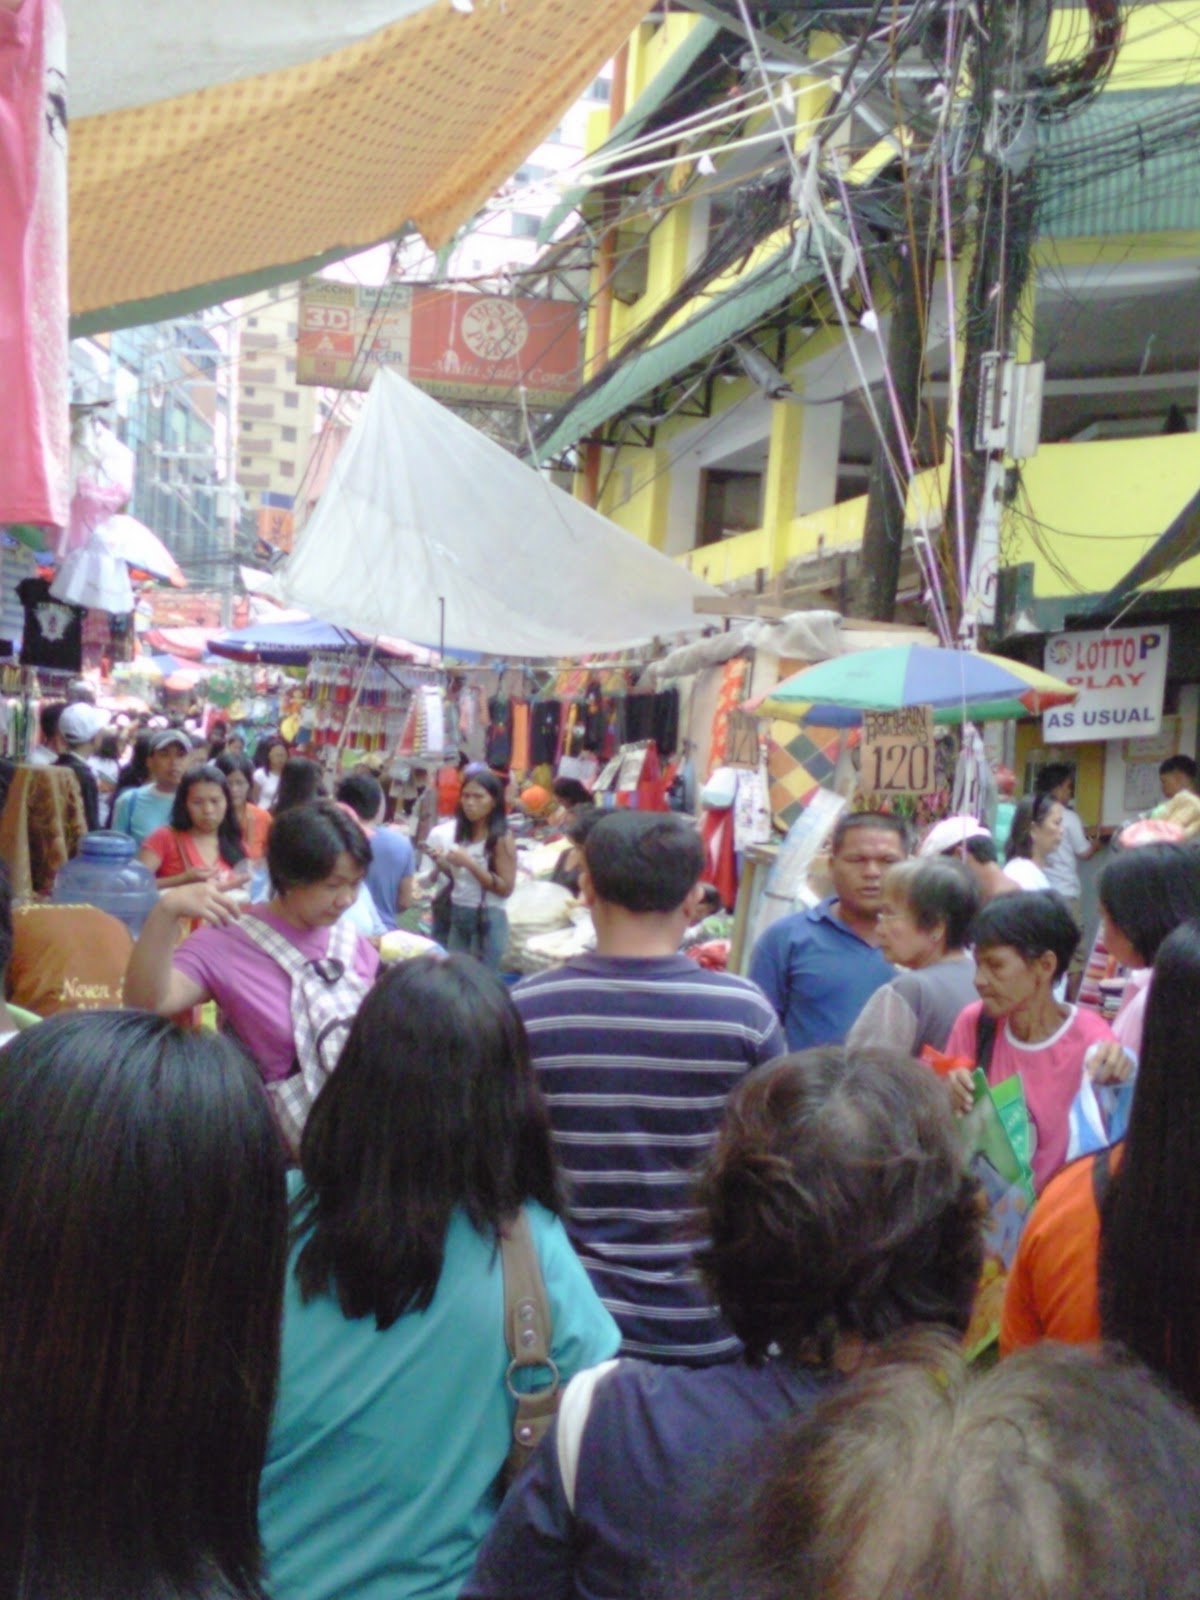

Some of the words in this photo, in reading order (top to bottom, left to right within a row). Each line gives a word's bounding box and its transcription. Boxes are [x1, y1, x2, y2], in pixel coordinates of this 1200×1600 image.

[306, 307, 350, 329] 3D
[1075, 637, 1136, 671] LOTTO
[1066, 672, 1146, 690] PLAY
[1047, 712, 1075, 728] AS
[1083, 707, 1155, 726] USUAL
[873, 744, 929, 790] 120
